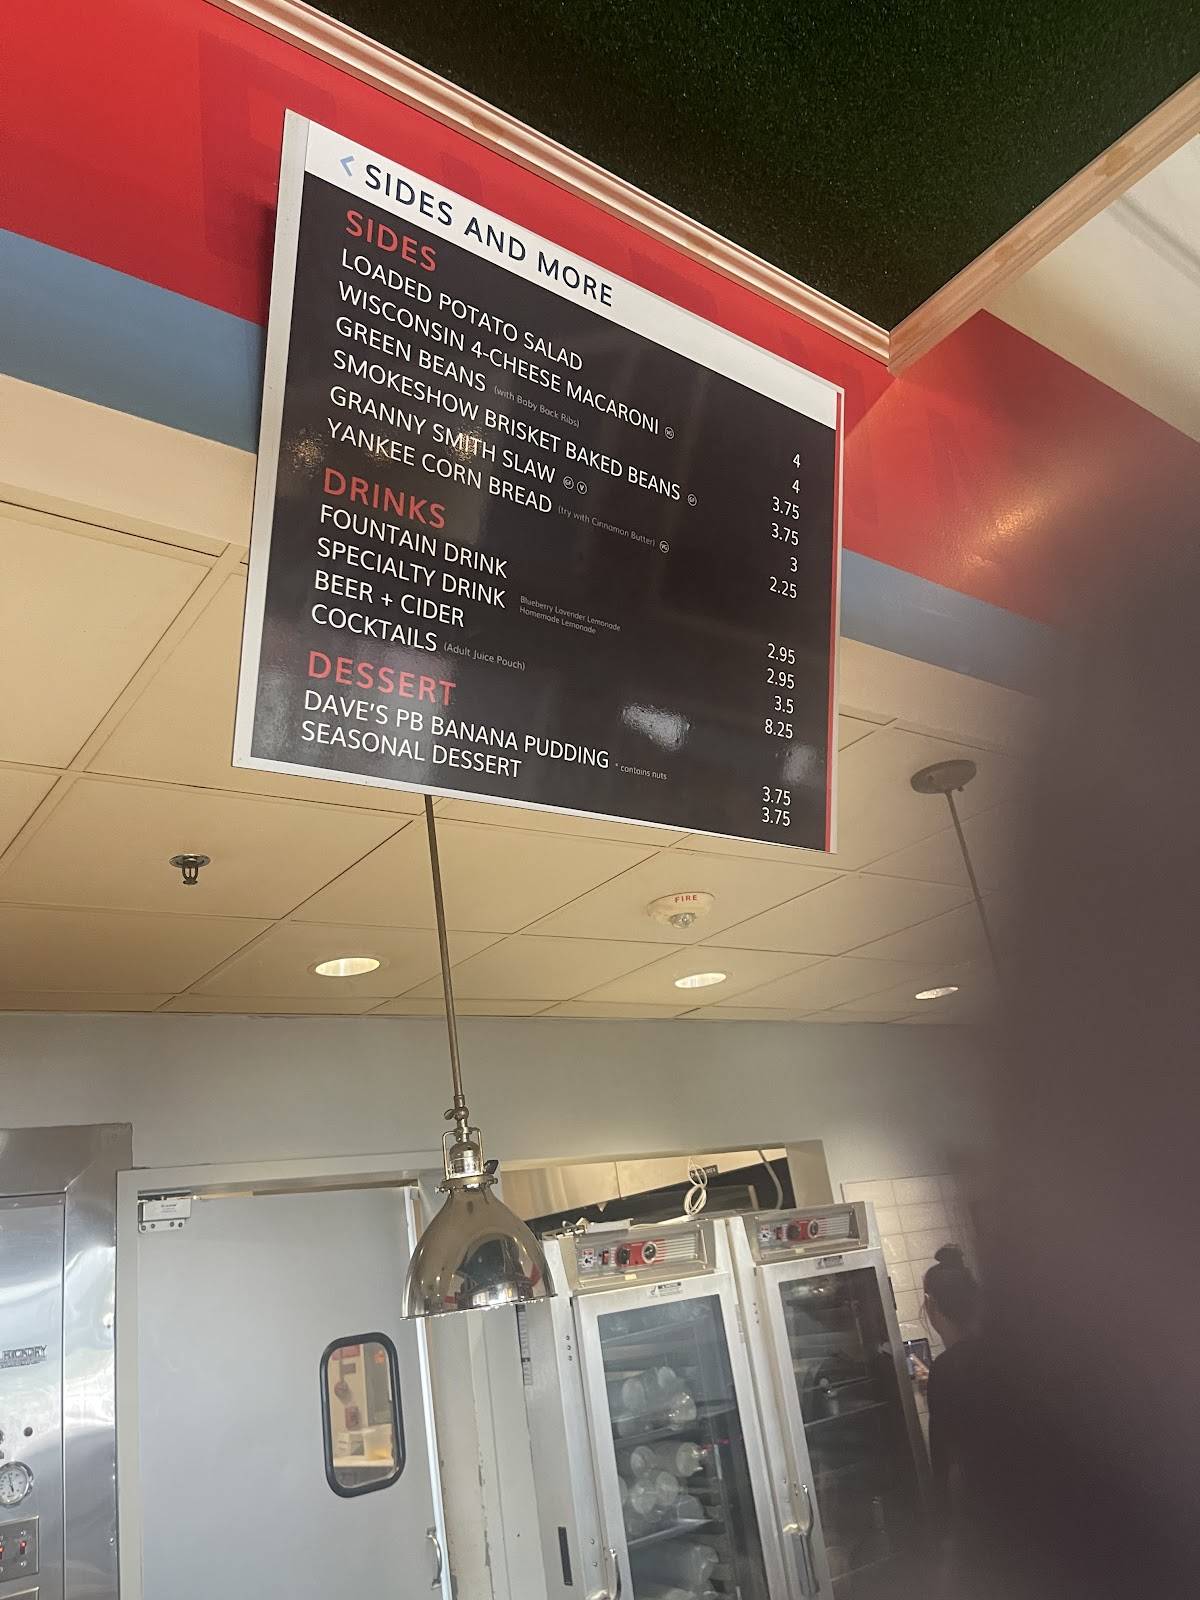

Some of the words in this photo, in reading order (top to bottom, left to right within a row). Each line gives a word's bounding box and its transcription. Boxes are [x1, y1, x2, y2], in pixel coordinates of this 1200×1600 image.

[347, 210, 436, 272] SIDES
[365, 163, 454, 228] SIDES
[464, 217, 526, 263] AND
[537, 250, 613, 308] MORE
[342, 248, 432, 303] LOADED
[439, 292, 518, 342] POTATO
[523, 331, 583, 371] SALAD
[336, 316, 411, 362] GREEN
[419, 349, 486, 392] BEANS
[494, 385, 515, 401] (with
[516, 394, 538, 412] Baby
[539, 404, 559, 420] Back
[560, 412, 580, 429] Ribs)
[338, 280, 465, 352] WISCONSIN
[471, 341, 561, 393] 4-CHEESE
[566, 380, 659, 435] MACARONI
[330, 385, 427, 435] GRANNY
[432, 423, 496, 462] SMITH
[502, 449, 556, 484] SLAW
[333, 349, 479, 421] SMOKESHOW
[485, 408, 562, 453] BRISKET
[565, 441, 623, 477] BAKED
[628, 465, 680, 501] BEANS
[327, 417, 415, 466] YANKEE
[422, 453, 482, 490] CORN
[489, 475, 552, 513] BREAD
[558, 504, 572, 518] (try
[574, 512, 590, 525] with
[591, 517, 630, 537] Cinnamon
[630, 530, 656, 547] Butter)
[792, 453, 801, 468] 4
[792, 479, 800, 494] 4
[323, 468, 445, 529] DRINKS
[772, 496, 800, 520] 3.75
[320, 503, 437, 557] FOUNTAIN
[444, 542, 508, 579] DRINK
[771, 522, 799, 546] 3.75
[317, 537, 436, 587] SPECIALTY
[442, 573, 506, 609] DRINK
[769, 576, 797, 599] 2.25
[790, 556, 798, 573] 3
[314, 569, 373, 604] BEER
[380, 593, 393, 607] +
[400, 594, 464, 628] CIDER
[519, 605, 560, 624] Homemade
[561, 618, 597, 635] Lemonade
[520, 595, 554, 614] Blueberry
[555, 605, 586, 623] Lavender
[586, 615, 621, 632] Lemonade
[311, 603, 437, 652] COCKTAILS
[443, 641, 471, 657] (Adult
[474, 649, 495, 664] Juice
[496, 655, 526, 672] Pouch)
[767, 642, 796, 665] 2.95
[308, 651, 455, 705] DESSERT
[767, 667, 795, 690] 2.95
[774, 695, 794, 714] 3.5
[301, 720, 425, 762] SEASONAL
[432, 744, 522, 778] DESSERT
[304, 689, 389, 725] DAVE'S
[396, 708, 423, 731] PB
[431, 715, 518, 751] BANANA
[524, 734, 609, 769] PUDDING
[620, 765, 651, 777] contains
[652, 770, 669, 781] nuts
[764, 718, 793, 739] 8.25
[762, 786, 791, 806] 3.75
[762, 806, 791, 827] 3.75
[675, 895, 697, 903] FIRE
